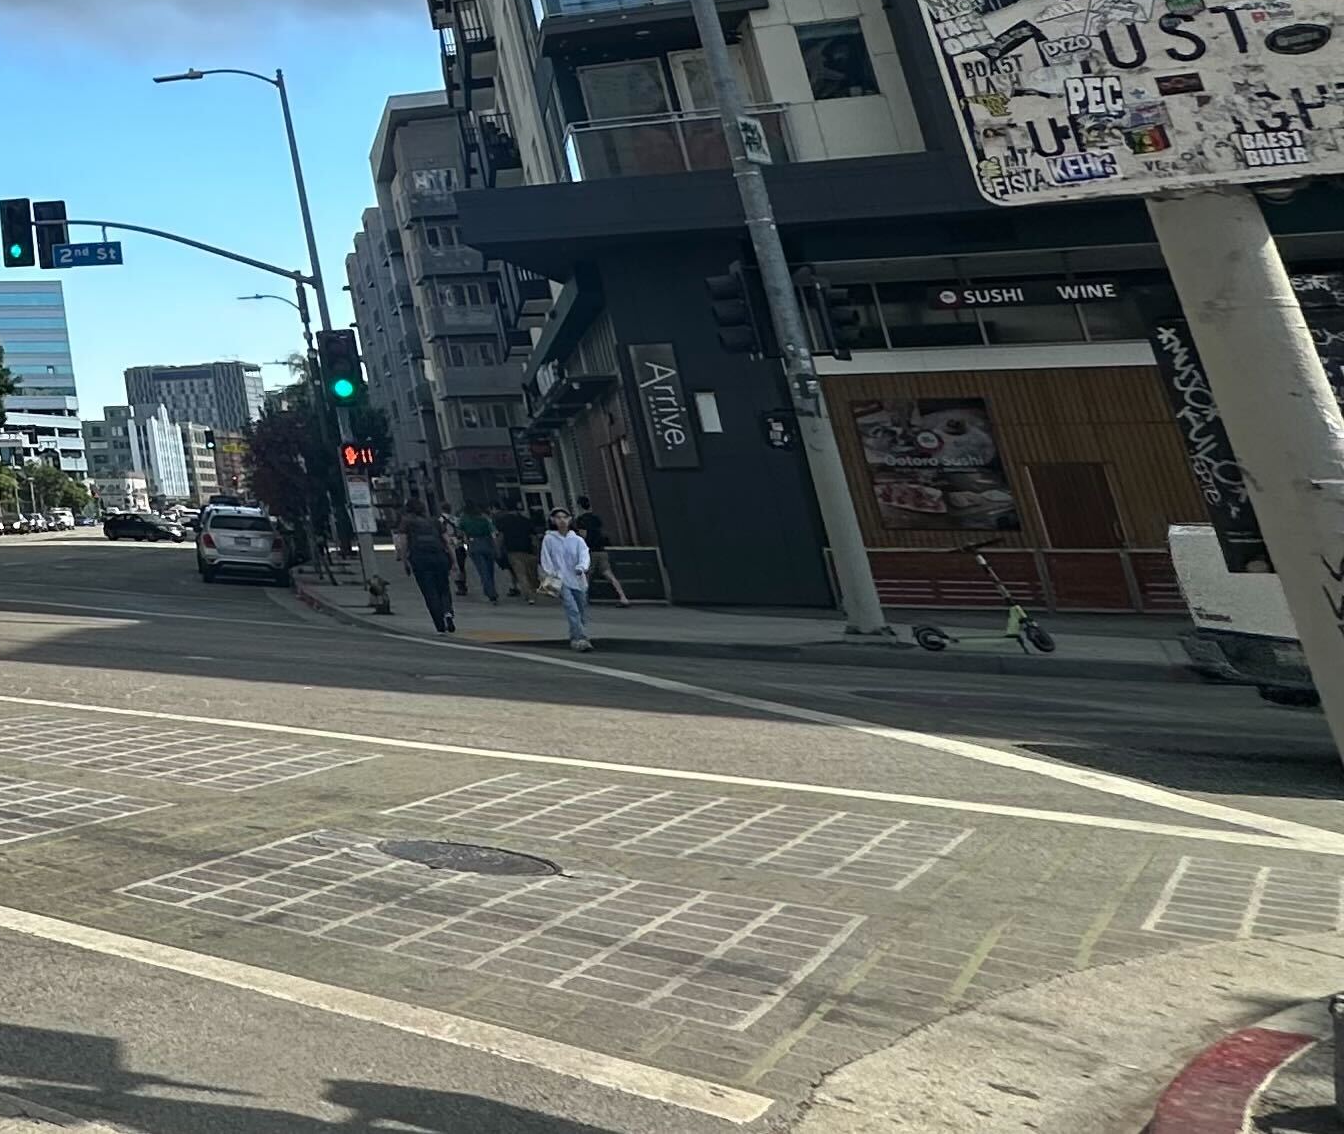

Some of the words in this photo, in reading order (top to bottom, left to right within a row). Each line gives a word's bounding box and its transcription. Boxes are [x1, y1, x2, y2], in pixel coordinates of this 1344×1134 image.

[59, 247, 89, 263] 2nd
[96, 247, 116, 260] St
[963, 288, 1025, 304] SUSHI
[1056, 283, 1117, 299] WINE
[941, 454, 984, 466] Sushi
